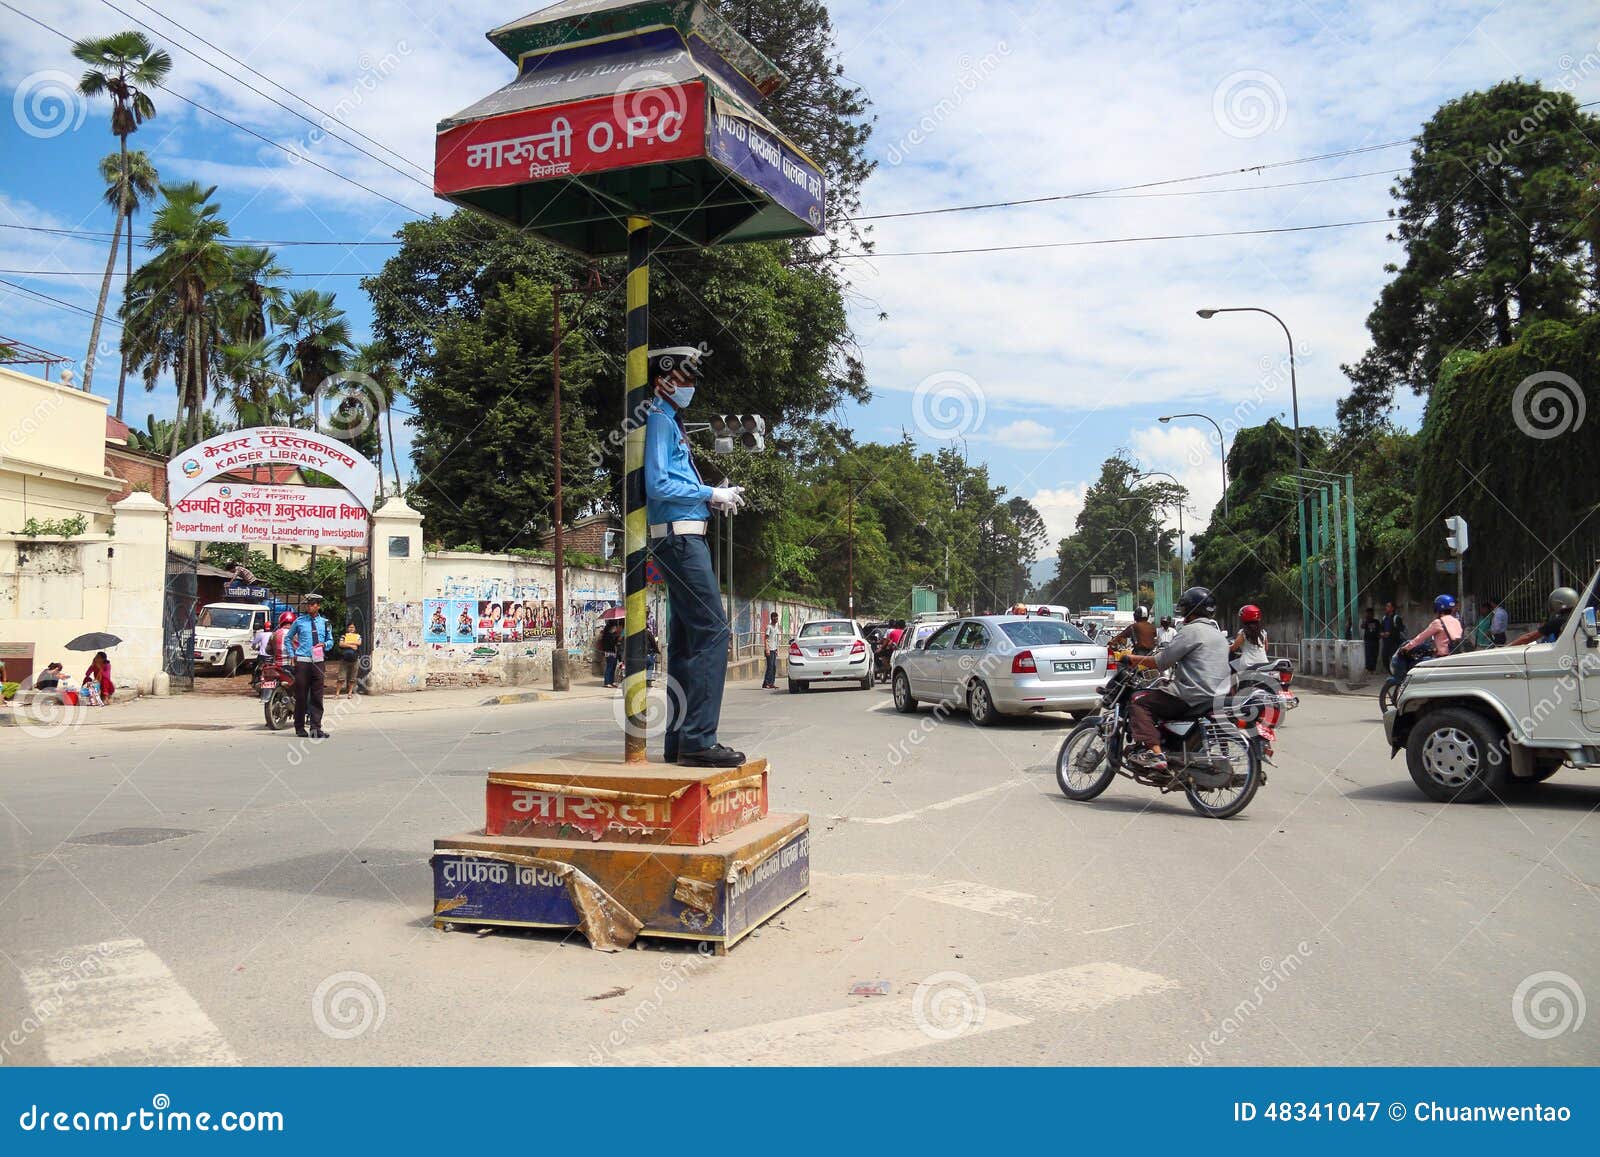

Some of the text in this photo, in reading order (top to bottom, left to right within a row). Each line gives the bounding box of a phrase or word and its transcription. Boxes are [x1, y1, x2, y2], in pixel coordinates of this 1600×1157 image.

[529, 160, 570, 178] सिमेन्ट
[203, 435, 357, 469] केसर पुस्तकालय
[215, 450, 328, 469] KAISER LIBRARY
[340, 504, 367, 520] विभाग
[176, 521, 364, 539] Department of Money Laundering Investigation
